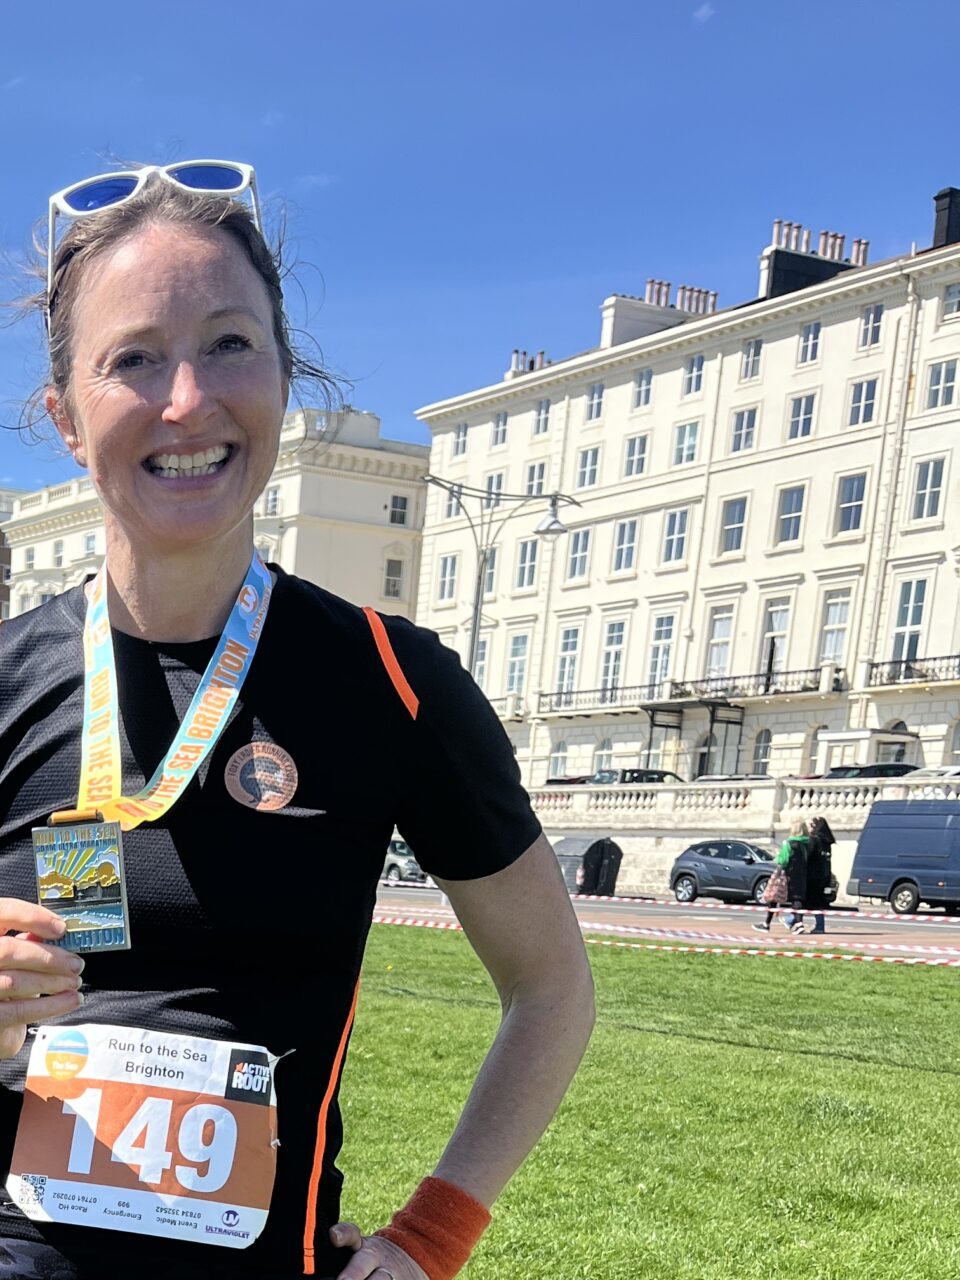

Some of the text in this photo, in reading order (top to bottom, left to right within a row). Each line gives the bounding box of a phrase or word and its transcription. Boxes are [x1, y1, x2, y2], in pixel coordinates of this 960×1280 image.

[89, 668, 111, 711] RUN
[186, 637, 251, 742] BRIGHTON
[88, 709, 112, 736] TO
[87, 735, 113, 773] THE
[167, 743, 206, 771] SEA
[86, 774, 113, 803] SEA
[155, 773, 186, 799] THE
[96, 825, 118, 840] SEA
[108, 1038, 208, 1063] Run to the Sea
[125, 1061, 185, 1080] Brighton
[242, 1062, 271, 1077] ACTIVE
[232, 1071, 270, 1093] ROOT
[62, 1087, 238, 1193] 149
[70, 1204, 88, 1213] Race
[102, 1207, 142, 1220] Emergency
[117, 1200, 130, 1209] 999
[156, 1216, 198, 1229] Event Medic
[205, 1225, 250, 1239] ULTRAVIOLET
